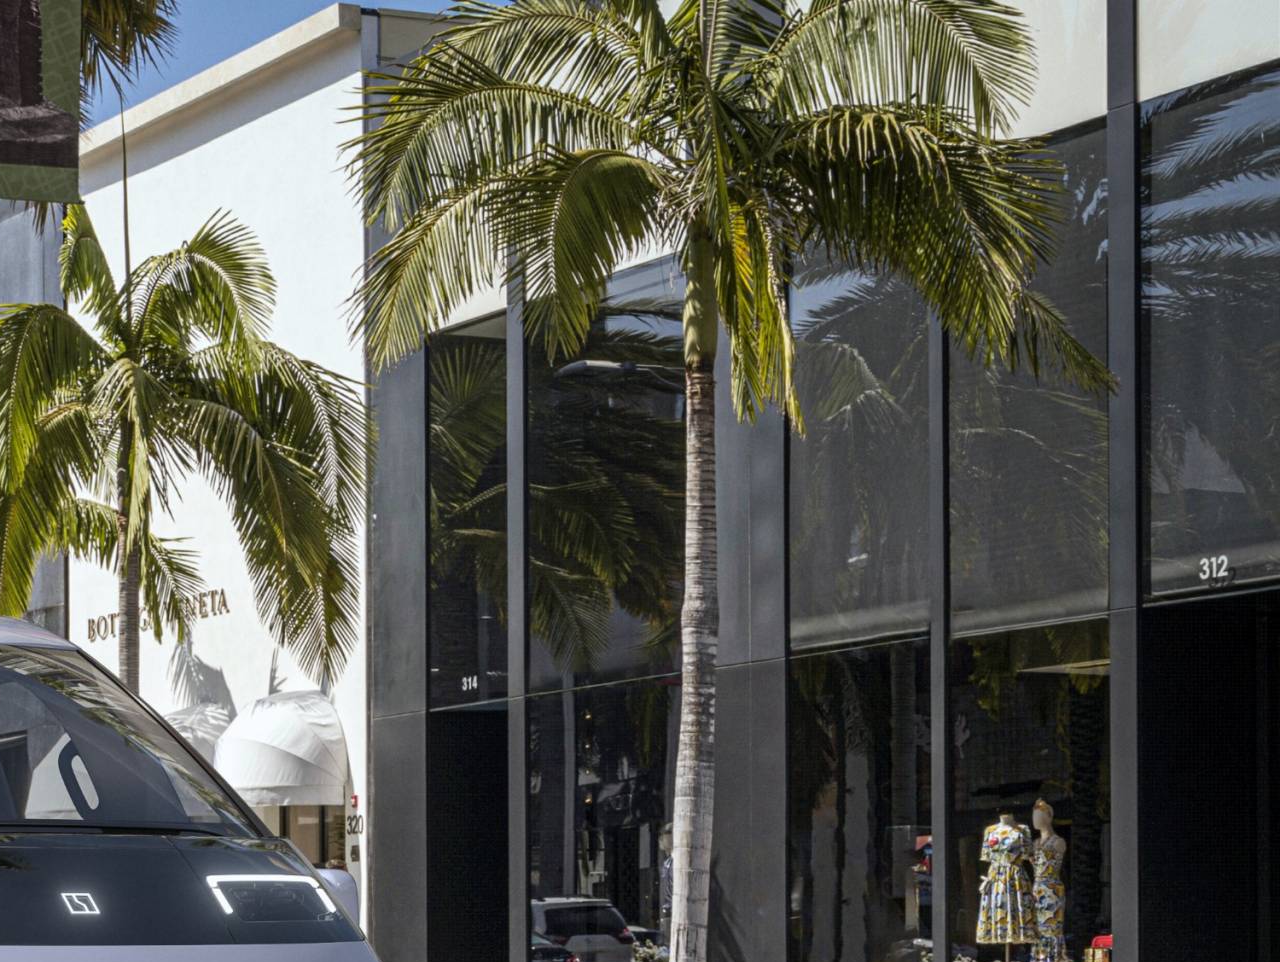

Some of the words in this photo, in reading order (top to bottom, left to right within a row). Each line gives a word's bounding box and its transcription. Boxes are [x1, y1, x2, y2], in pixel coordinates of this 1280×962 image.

[1199, 555, 1229, 580] 312
[462, 675, 478, 691] 314
[346, 815, 364, 835] 320
